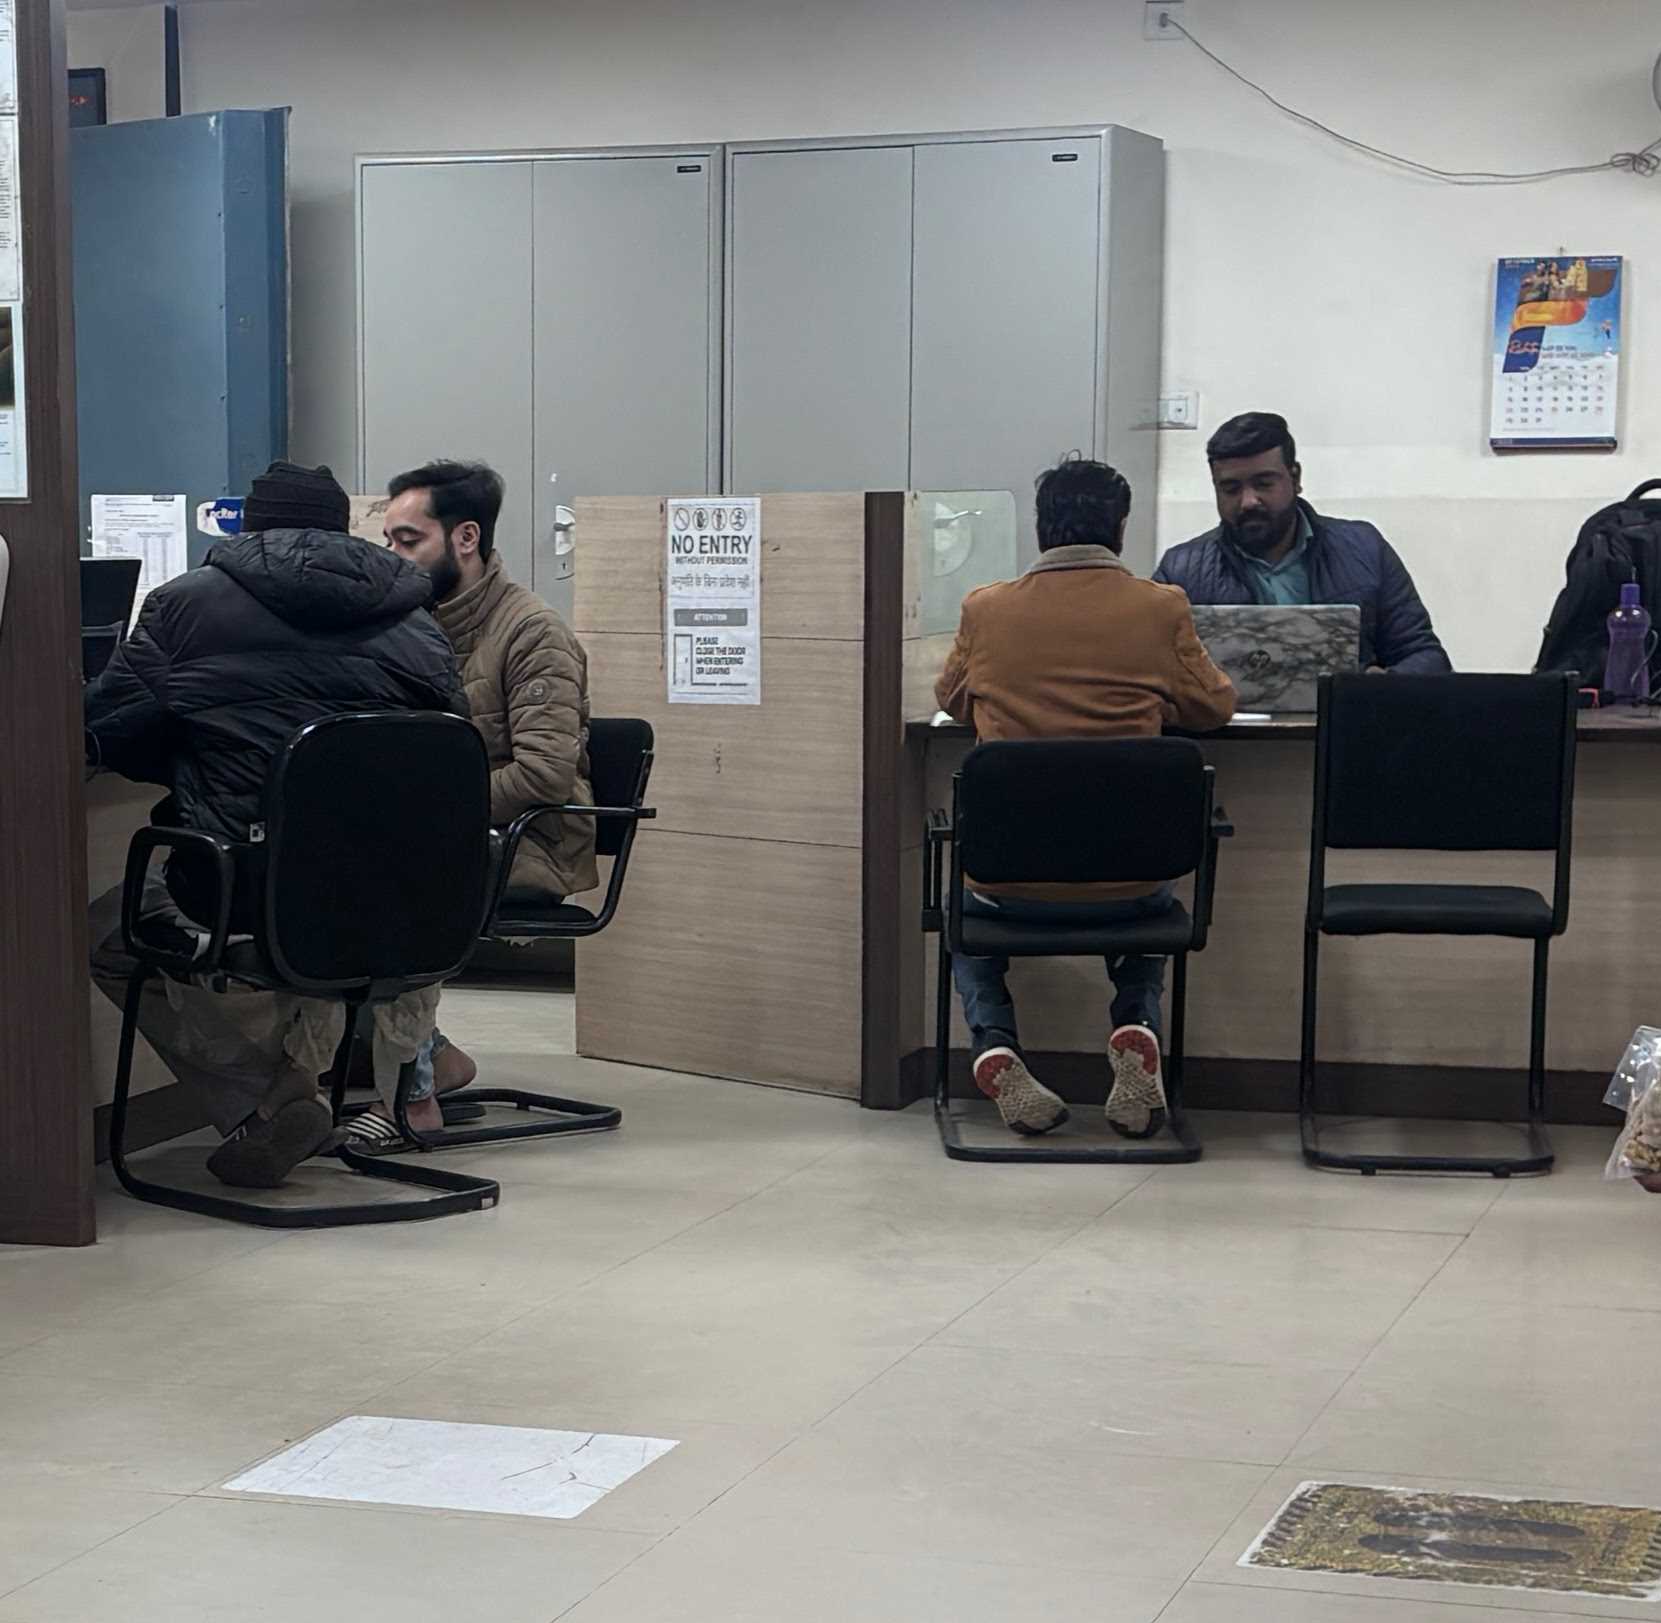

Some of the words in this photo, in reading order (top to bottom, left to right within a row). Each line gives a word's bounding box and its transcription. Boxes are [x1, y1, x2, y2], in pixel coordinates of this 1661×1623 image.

[671, 535, 694, 554] NO
[699, 535, 752, 554] ENTRY
[675, 556, 704, 565] WITHOUT
[706, 556, 748, 565] PERMISSION
